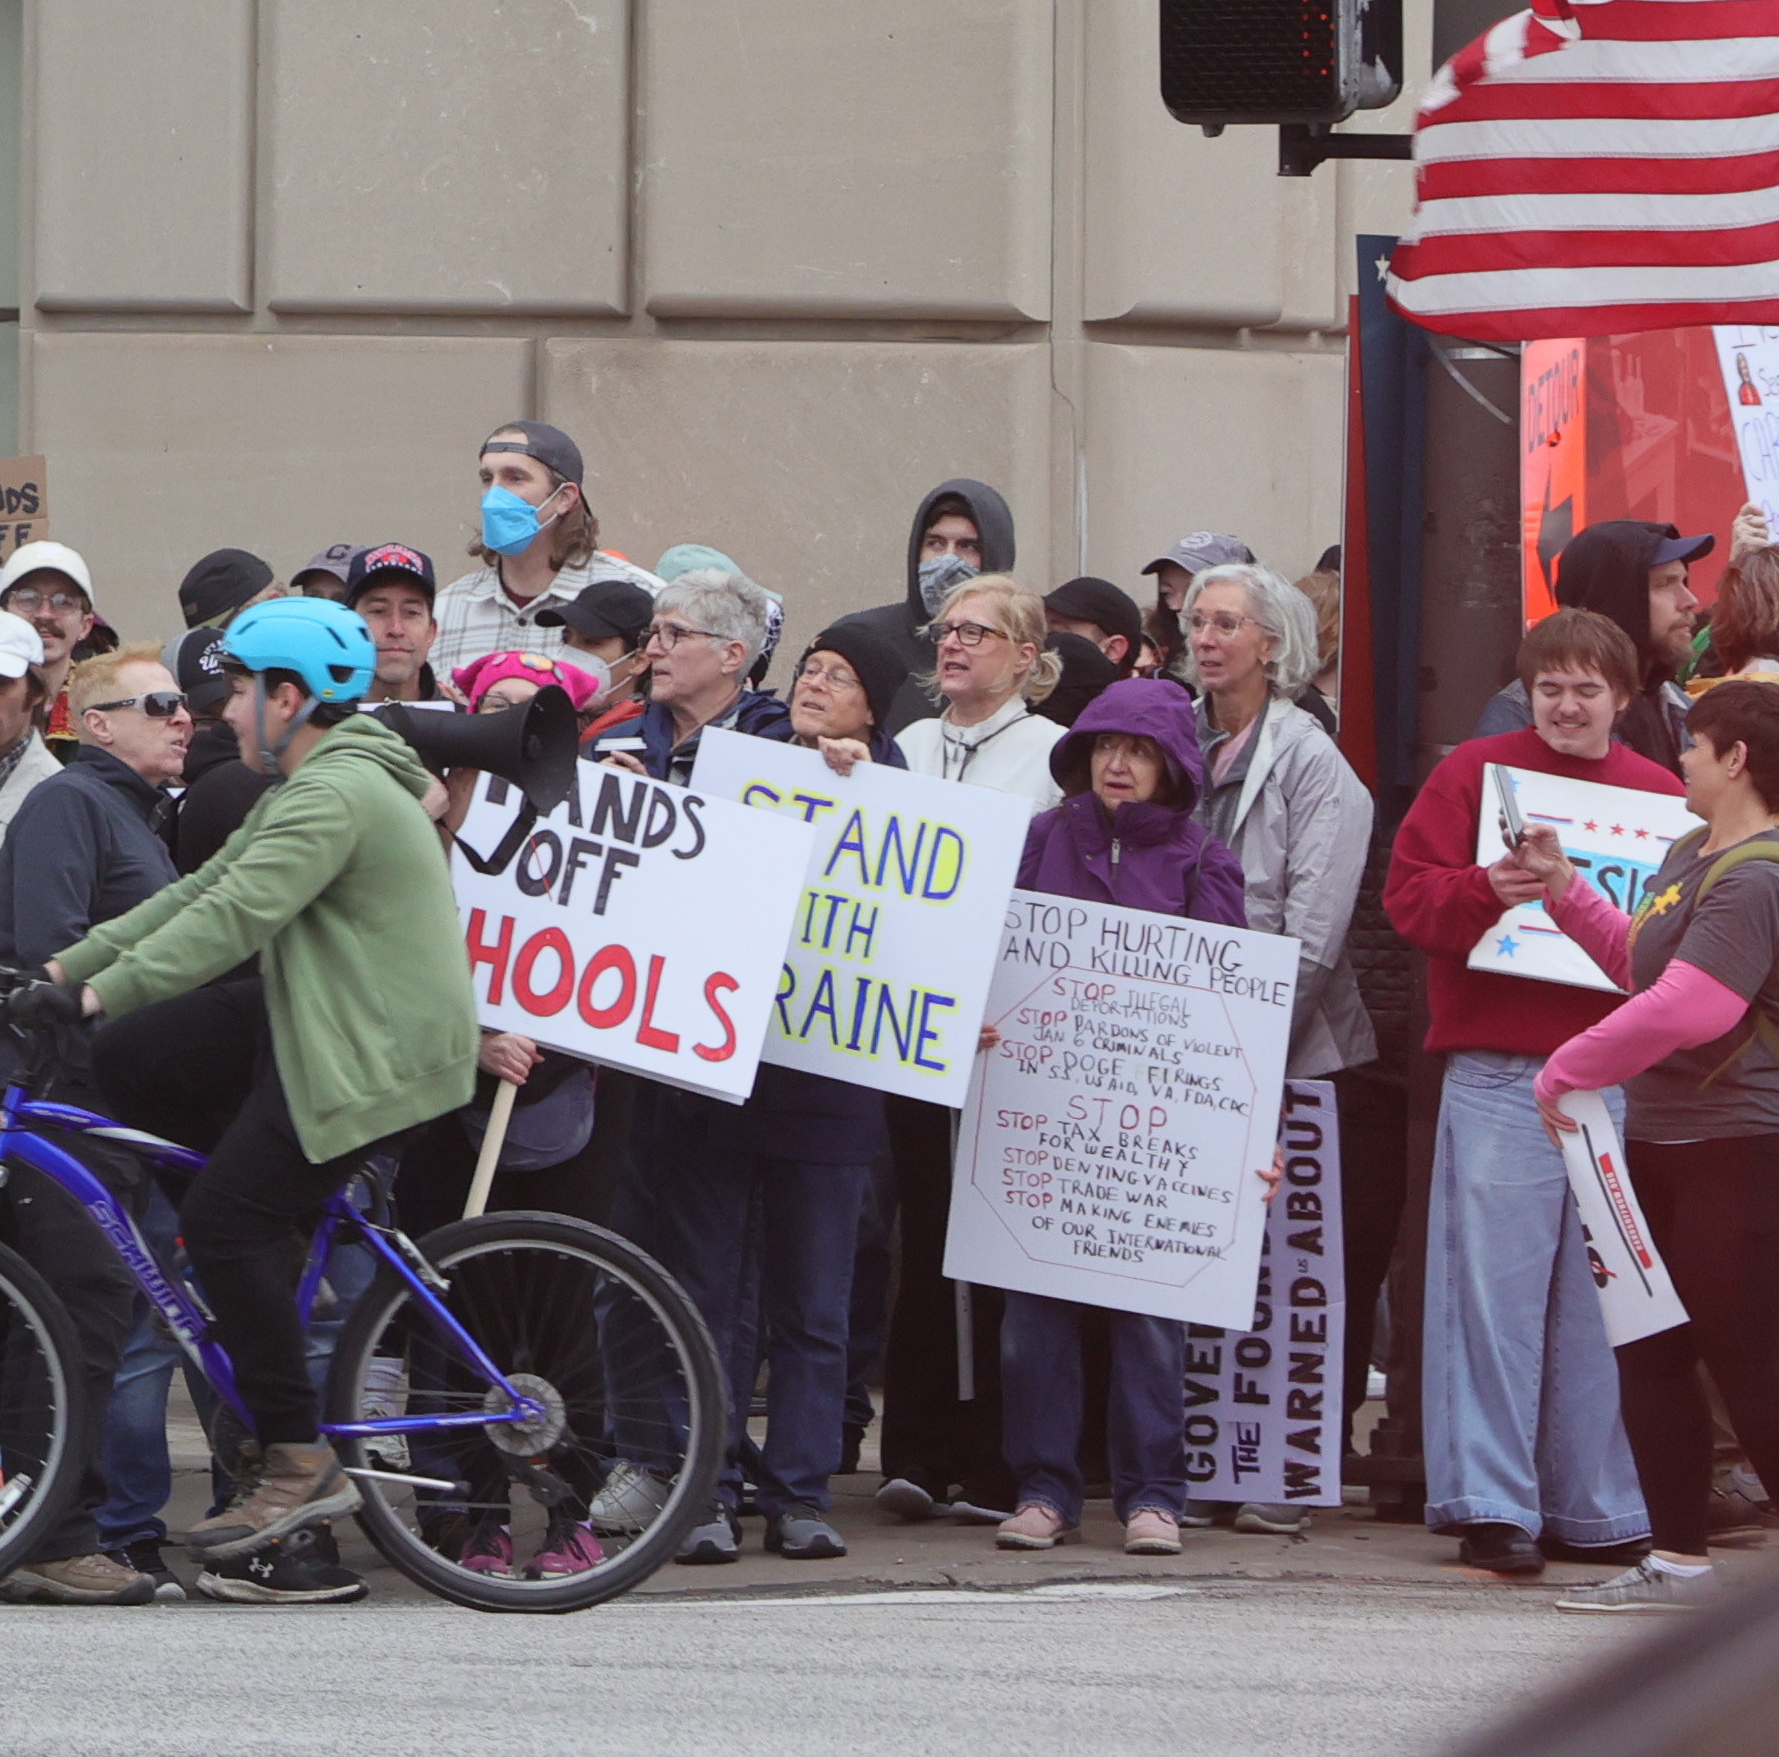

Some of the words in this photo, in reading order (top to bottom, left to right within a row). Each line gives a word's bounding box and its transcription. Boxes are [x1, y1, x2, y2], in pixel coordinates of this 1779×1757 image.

[514, 829, 641, 917] OFF
[1004, 899, 1087, 940] STOP
[1100, 916, 1244, 973] HURTING
[1003, 935, 1071, 969] AND
[1092, 946, 1192, 986] KILLING
[1209, 967, 1290, 1007] PEOPLE
[1052, 976, 1116, 1001] STOP
[1127, 989, 1191, 1016] ILLEGAL
[1071, 996, 1191, 1030] DEPORTATIONS
[1016, 1007, 1068, 1028] STOP
[1074, 1014, 1149, 1046] PARDONS
[1156, 1032, 1177, 1047] OF
[1183, 1037, 1243, 1061] VIOLENT
[1033, 1026, 1065, 1044] JAN
[1073, 1027, 1085, 1048] 6
[1092, 1036, 1184, 1065] CRIMINALS
[999, 1039, 1054, 1065] STOP
[1063, 1050, 1126, 1077] DOGE
[1017, 1057, 1039, 1075] IN
[996, 1109, 1049, 1132] STOP
[1056, 1120, 1101, 1142] TAX
[1118, 1131, 1199, 1161] BREAKS
[1066, 1094, 1168, 1135] STOP
[1002, 1147, 1049, 1166] STOP
[1052, 1155, 1140, 1186] DENYING
[1143, 1174, 1234, 1204] VACCINES
[1038, 1132, 1074, 1152] FOR
[1084, 1142, 1190, 1178] WEALTHY
[1285, 1083, 1325, 1256] ABOUT
[1001, 1167, 1053, 1189] STOP
[1057, 1177, 1120, 1202] TRADE
[1126, 1190, 1168, 1209] WAR
[1004, 1190, 1054, 1209] STOP
[1059, 1197, 1134, 1224] MAKING
[1031, 1214, 1055, 1230] OF
[1061, 1220, 1098, 1241] OUR
[1073, 1239, 1145, 1264] FRIENDS
[1283, 1275, 1329, 1501] WARNED
[1231, 1421, 1262, 1486] THE
